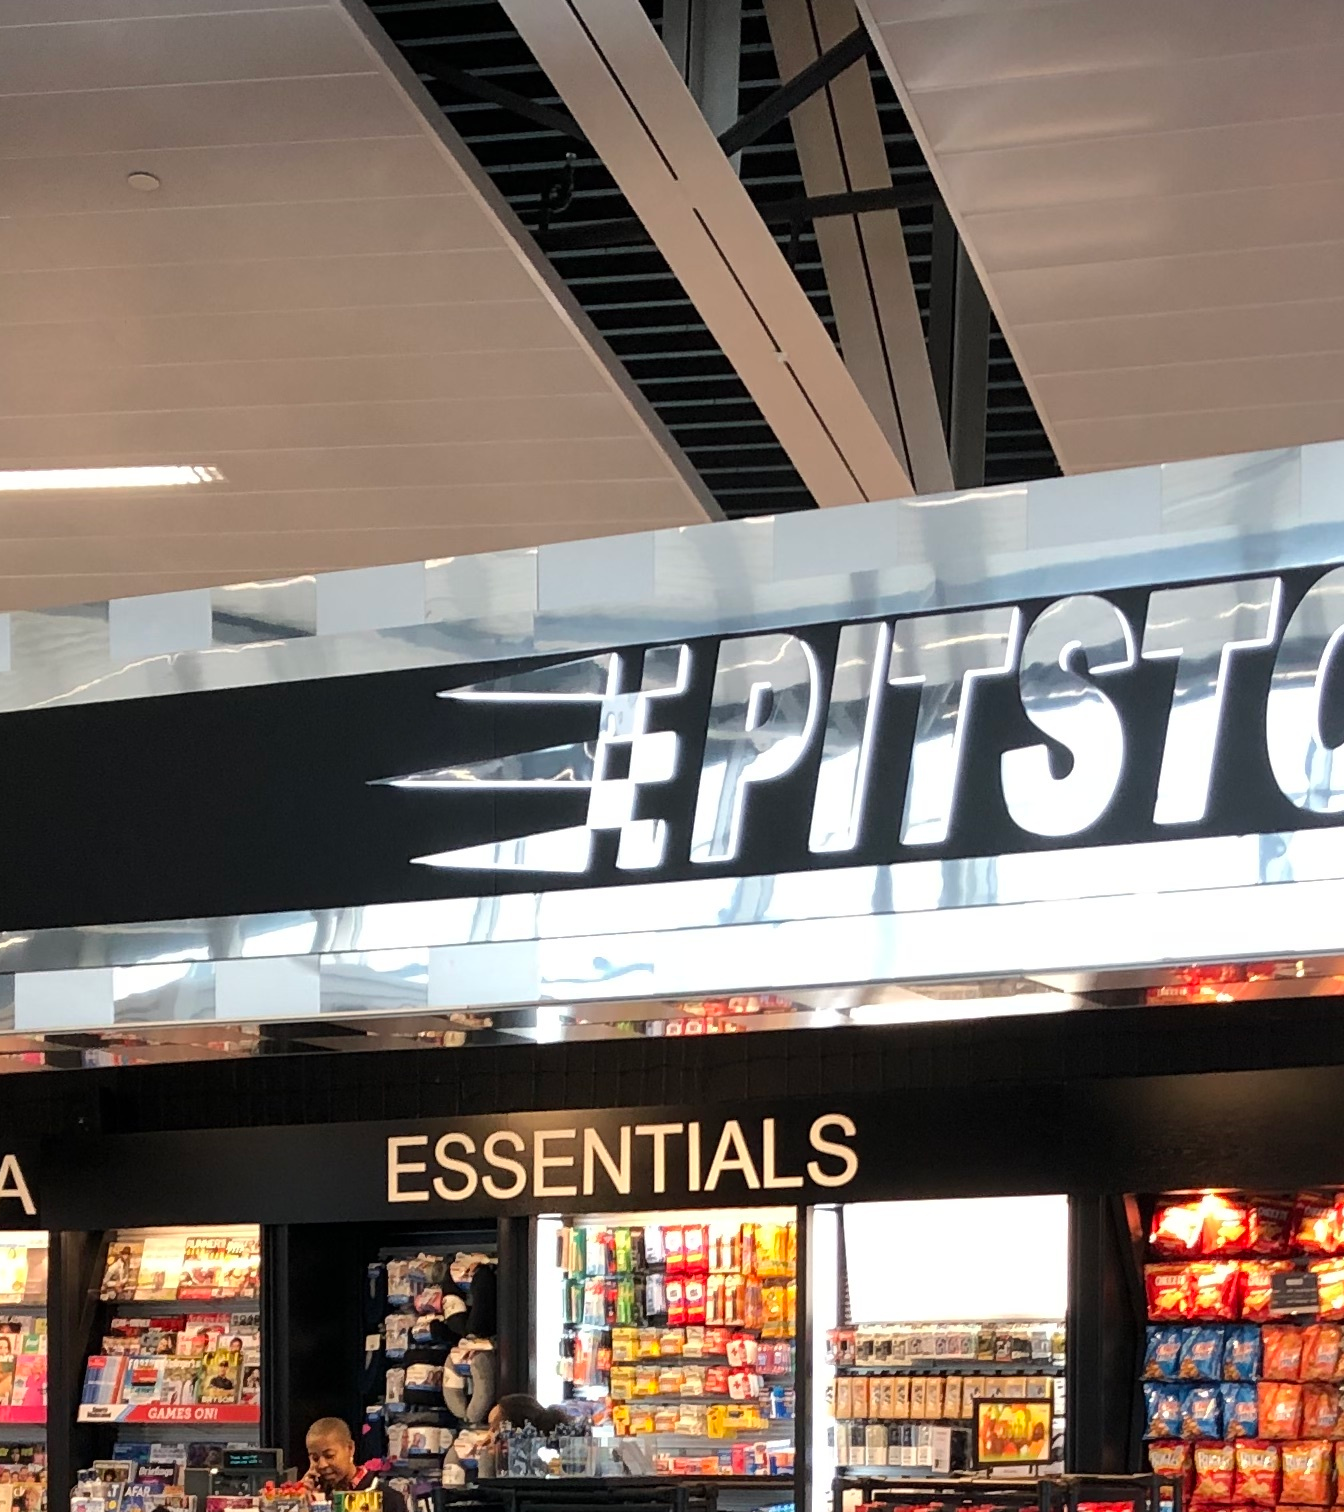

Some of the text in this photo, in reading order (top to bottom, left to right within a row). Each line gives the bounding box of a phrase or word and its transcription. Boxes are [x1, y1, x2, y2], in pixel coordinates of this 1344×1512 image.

[387, 1113, 858, 1203] ESSENTIALS
[148, 1407, 218, 1420] GAMES ON!
[125, 1486, 150, 1497] AFAR
